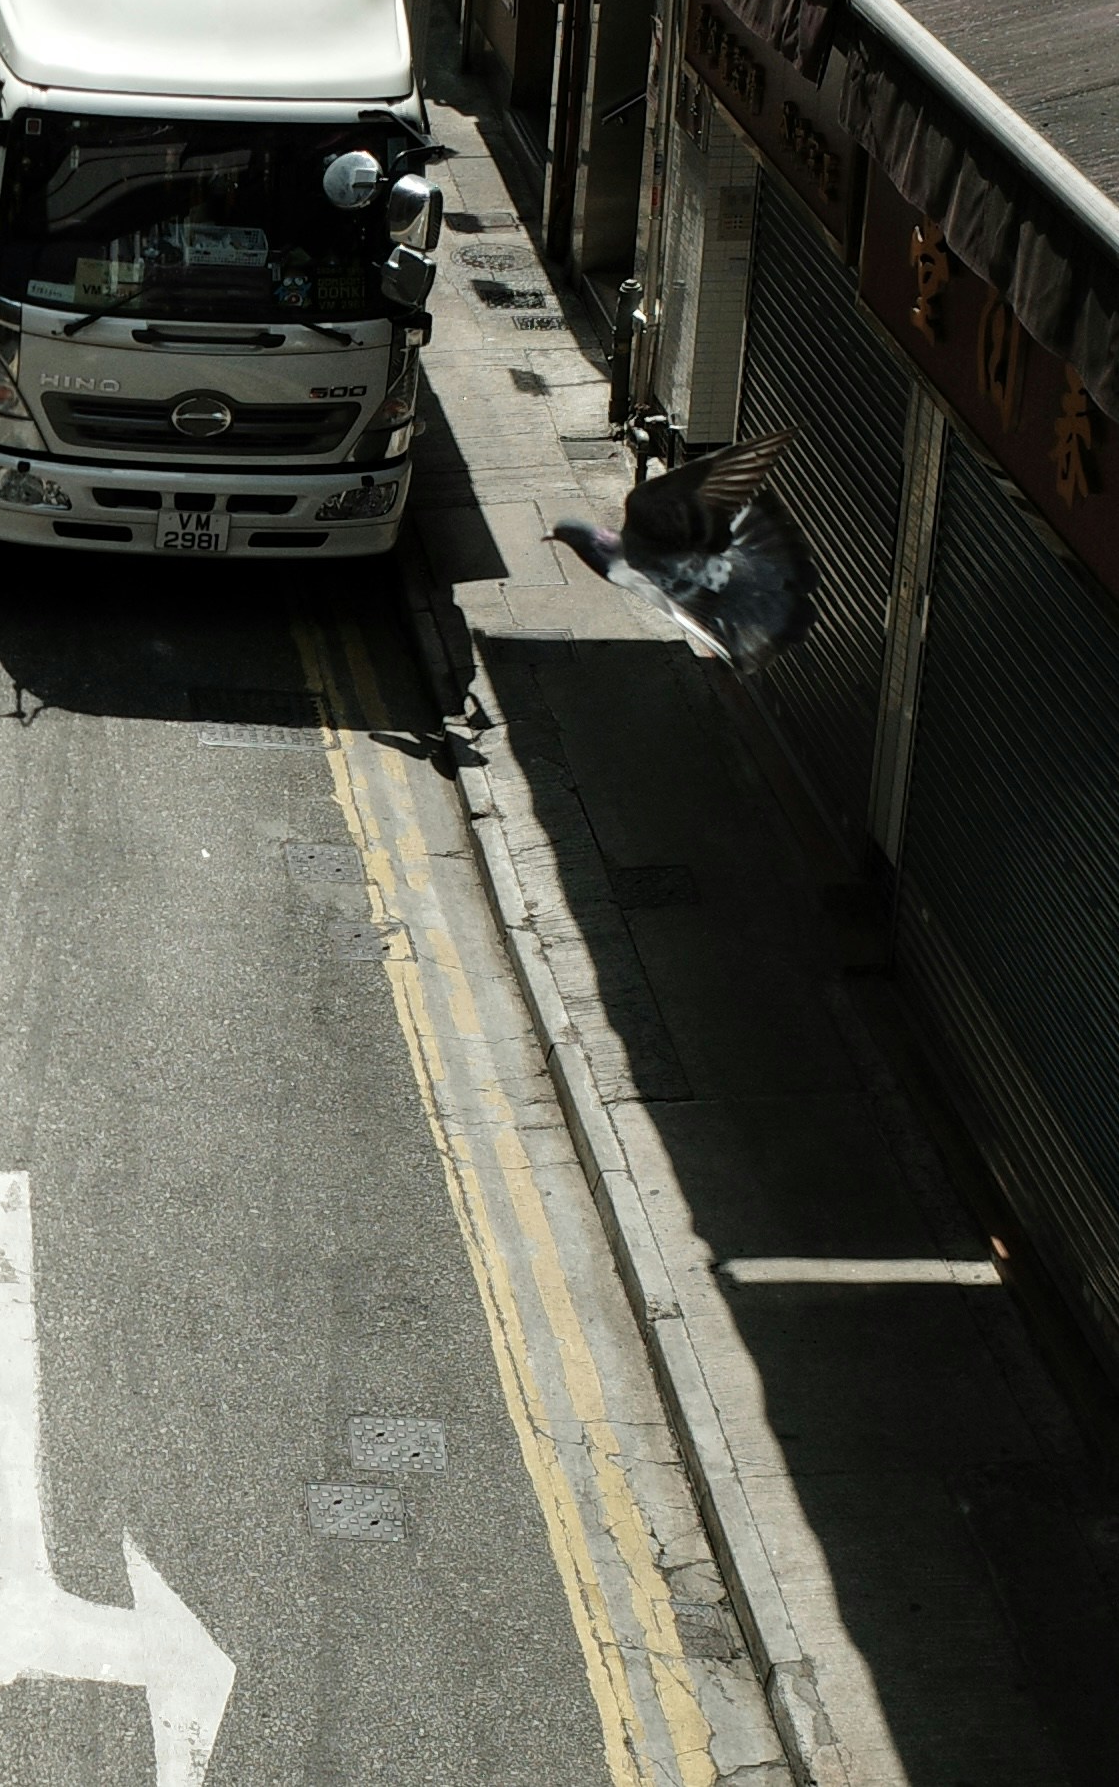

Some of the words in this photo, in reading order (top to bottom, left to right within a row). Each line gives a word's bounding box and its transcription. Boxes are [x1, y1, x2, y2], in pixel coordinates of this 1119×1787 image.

[318, 286, 365, 301] DONKI
[40, 373, 120, 392] HINO
[309, 385, 367, 399] 500
[179, 513, 211, 531] VM
[163, 531, 220, 551] 2981
